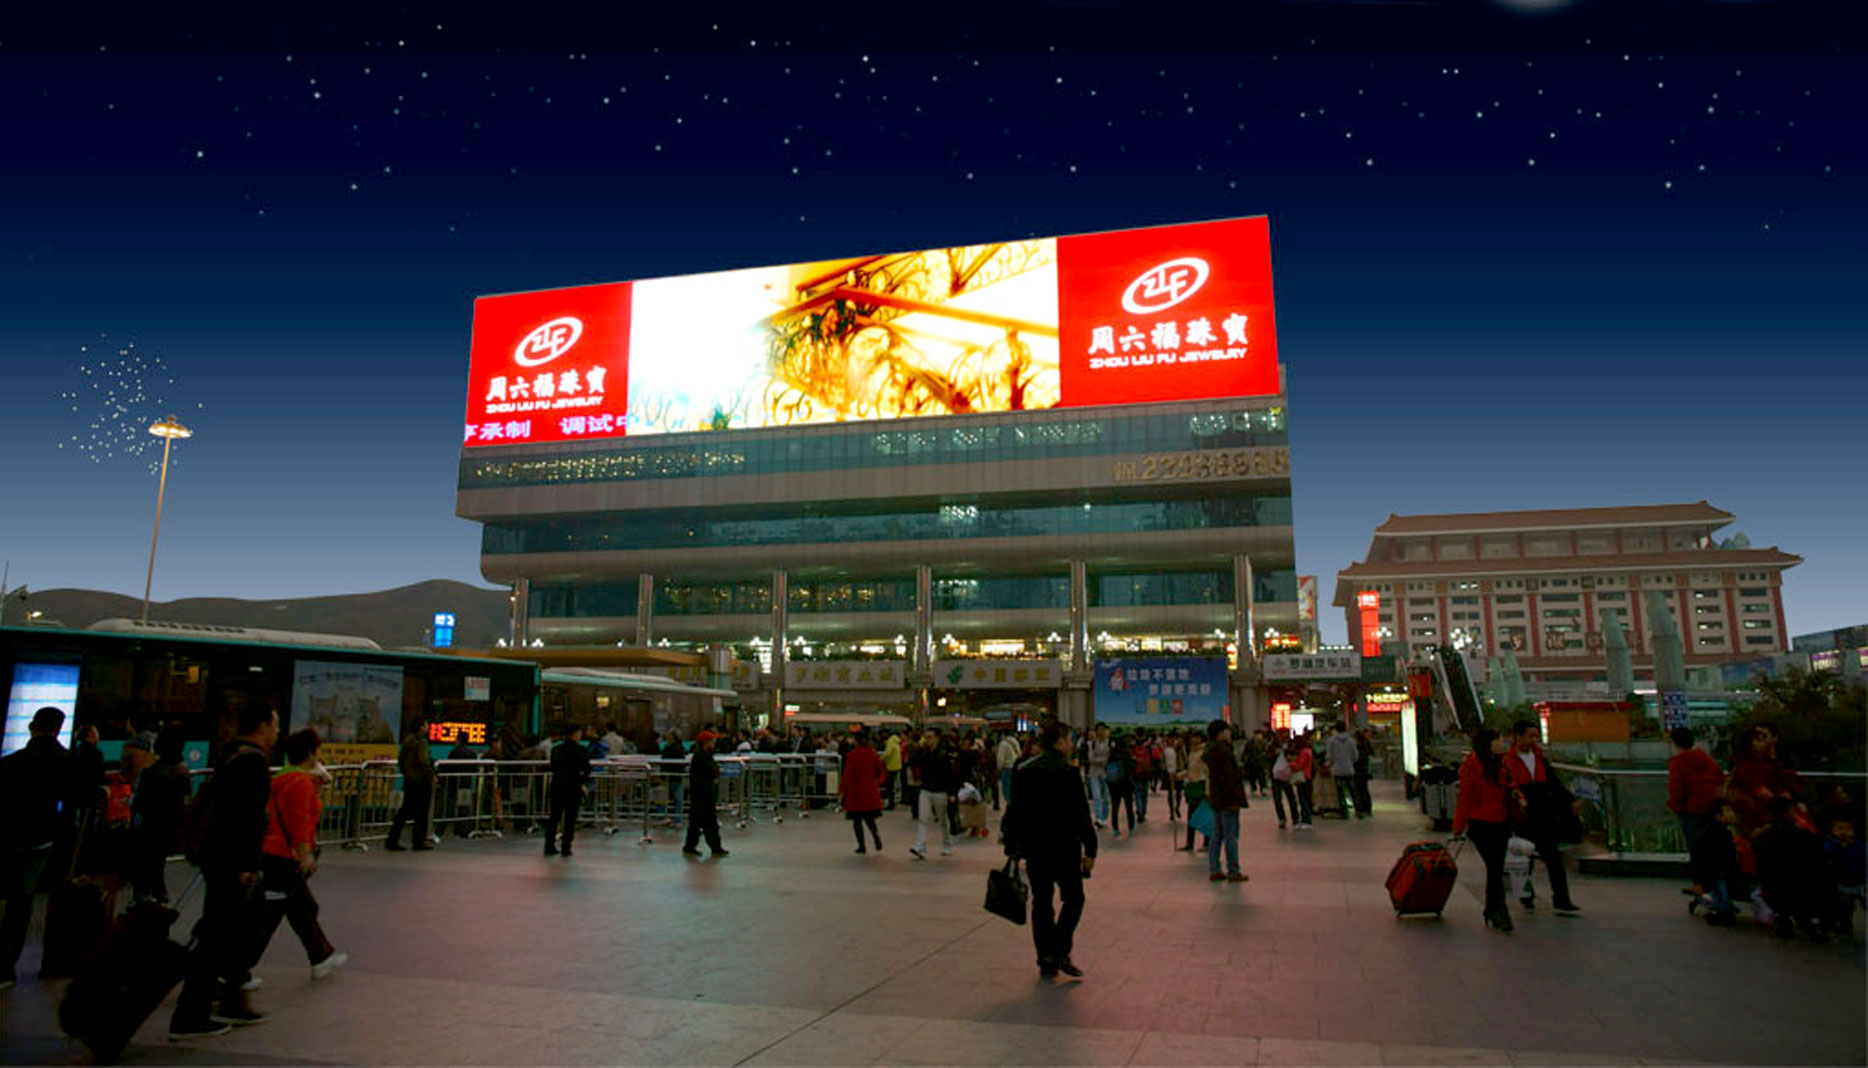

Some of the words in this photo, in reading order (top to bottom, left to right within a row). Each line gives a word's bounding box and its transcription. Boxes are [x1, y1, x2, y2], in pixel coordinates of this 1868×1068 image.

[1089, 356, 1129, 369] ZHOU
[1131, 355, 1154, 366] LIU
[1156, 353, 1177, 364] FU
[1179, 348, 1247, 362] JEWELRY
[486, 403, 515, 414] ZHOU
[517, 401, 534, 411] LIU
[535, 400, 550, 410] FU
[552, 396, 603, 409] JEWELRY
